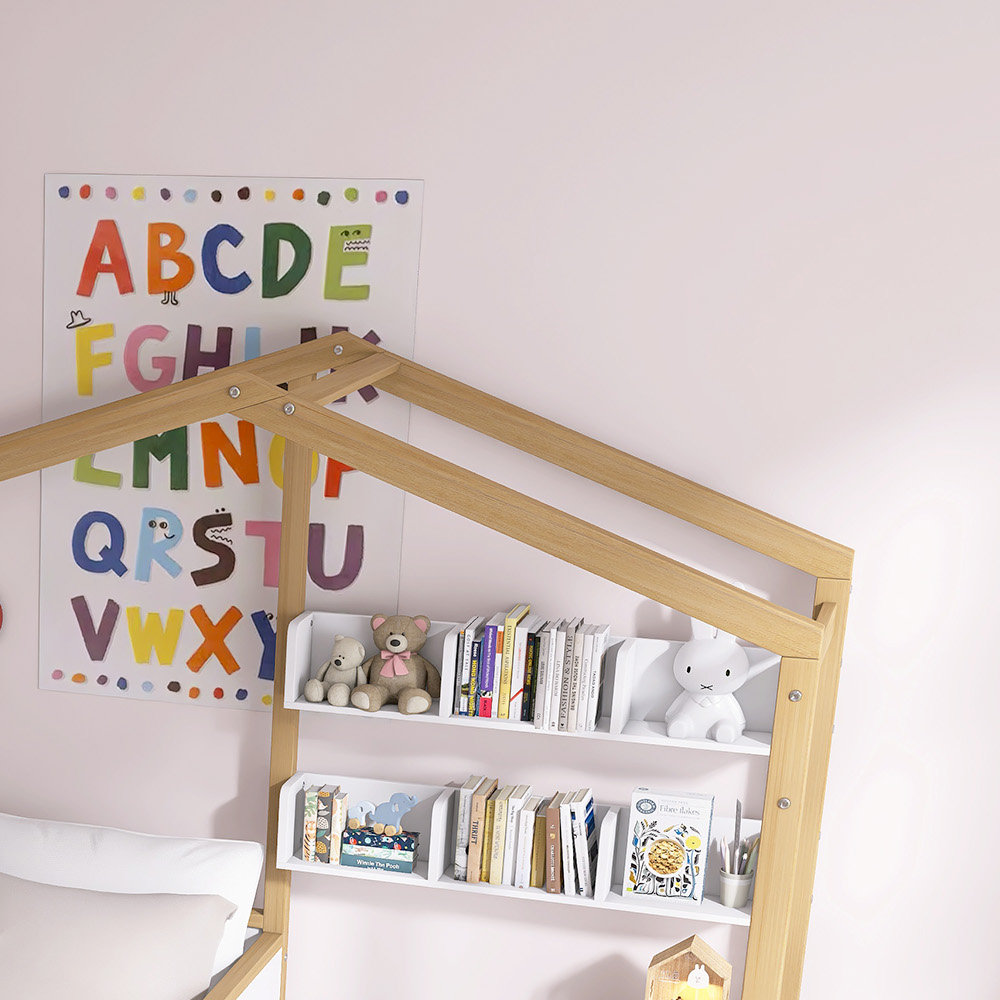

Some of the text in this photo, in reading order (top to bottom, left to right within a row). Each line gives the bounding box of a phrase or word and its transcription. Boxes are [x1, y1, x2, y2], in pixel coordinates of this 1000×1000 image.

[560, 676, 569, 719] FASHION
[565, 635, 573, 664] STYLE
[659, 805, 679, 814] Fibre
[679, 806, 701, 816] flakes
[470, 820, 479, 845] THRIFT
[356, 859, 375, 868] Winnie
[385, 862, 400, 870] Pooh
